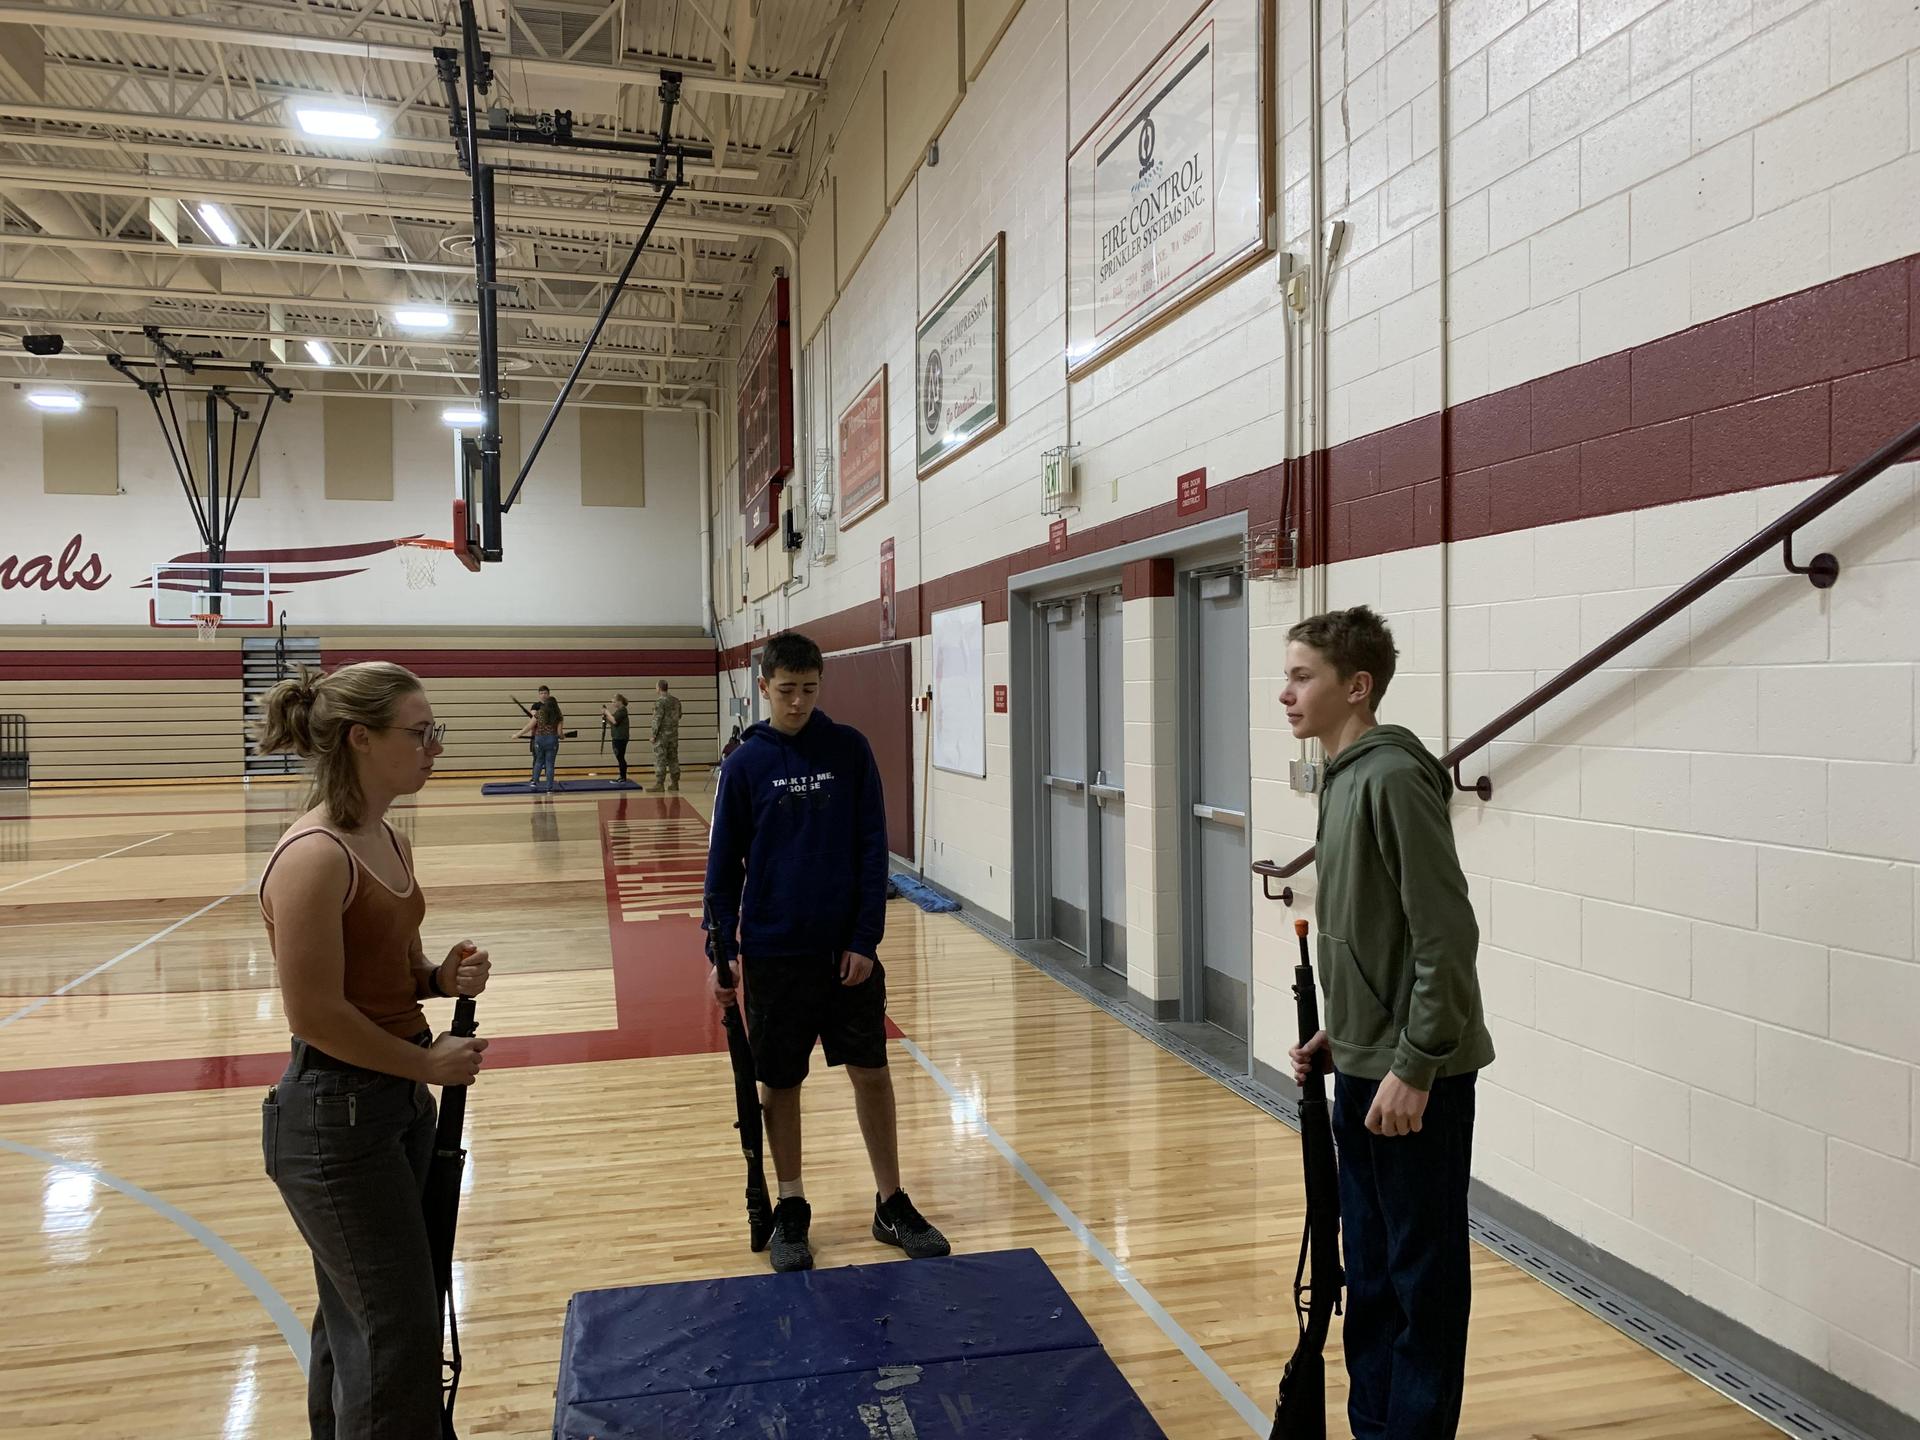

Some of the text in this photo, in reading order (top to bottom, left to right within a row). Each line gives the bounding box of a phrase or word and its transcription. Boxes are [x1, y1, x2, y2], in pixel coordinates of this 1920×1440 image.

[1100, 185, 1206, 284] SPRINKLER SYSTEMS INC.
[1101, 152, 1203, 262] FIRE CONTROL
